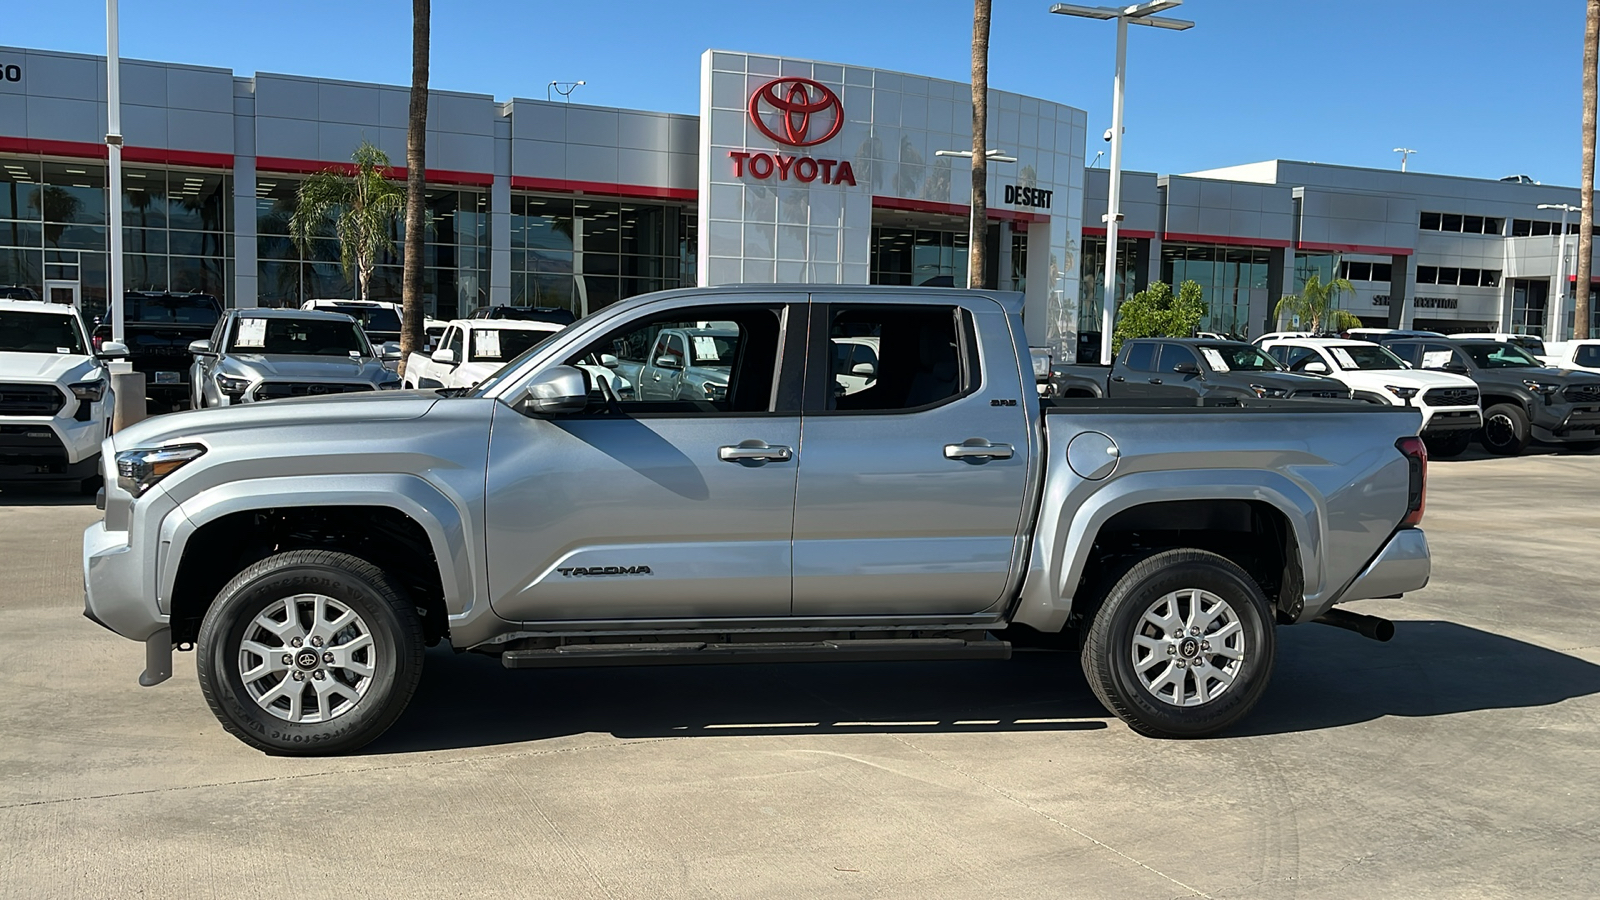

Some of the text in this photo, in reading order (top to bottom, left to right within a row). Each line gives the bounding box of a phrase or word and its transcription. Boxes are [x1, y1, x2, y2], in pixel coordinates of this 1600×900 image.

[728, 151, 857, 186] TOYOTA
[1004, 184, 1053, 209] DESERT
[557, 565, 651, 576] TACOMA
